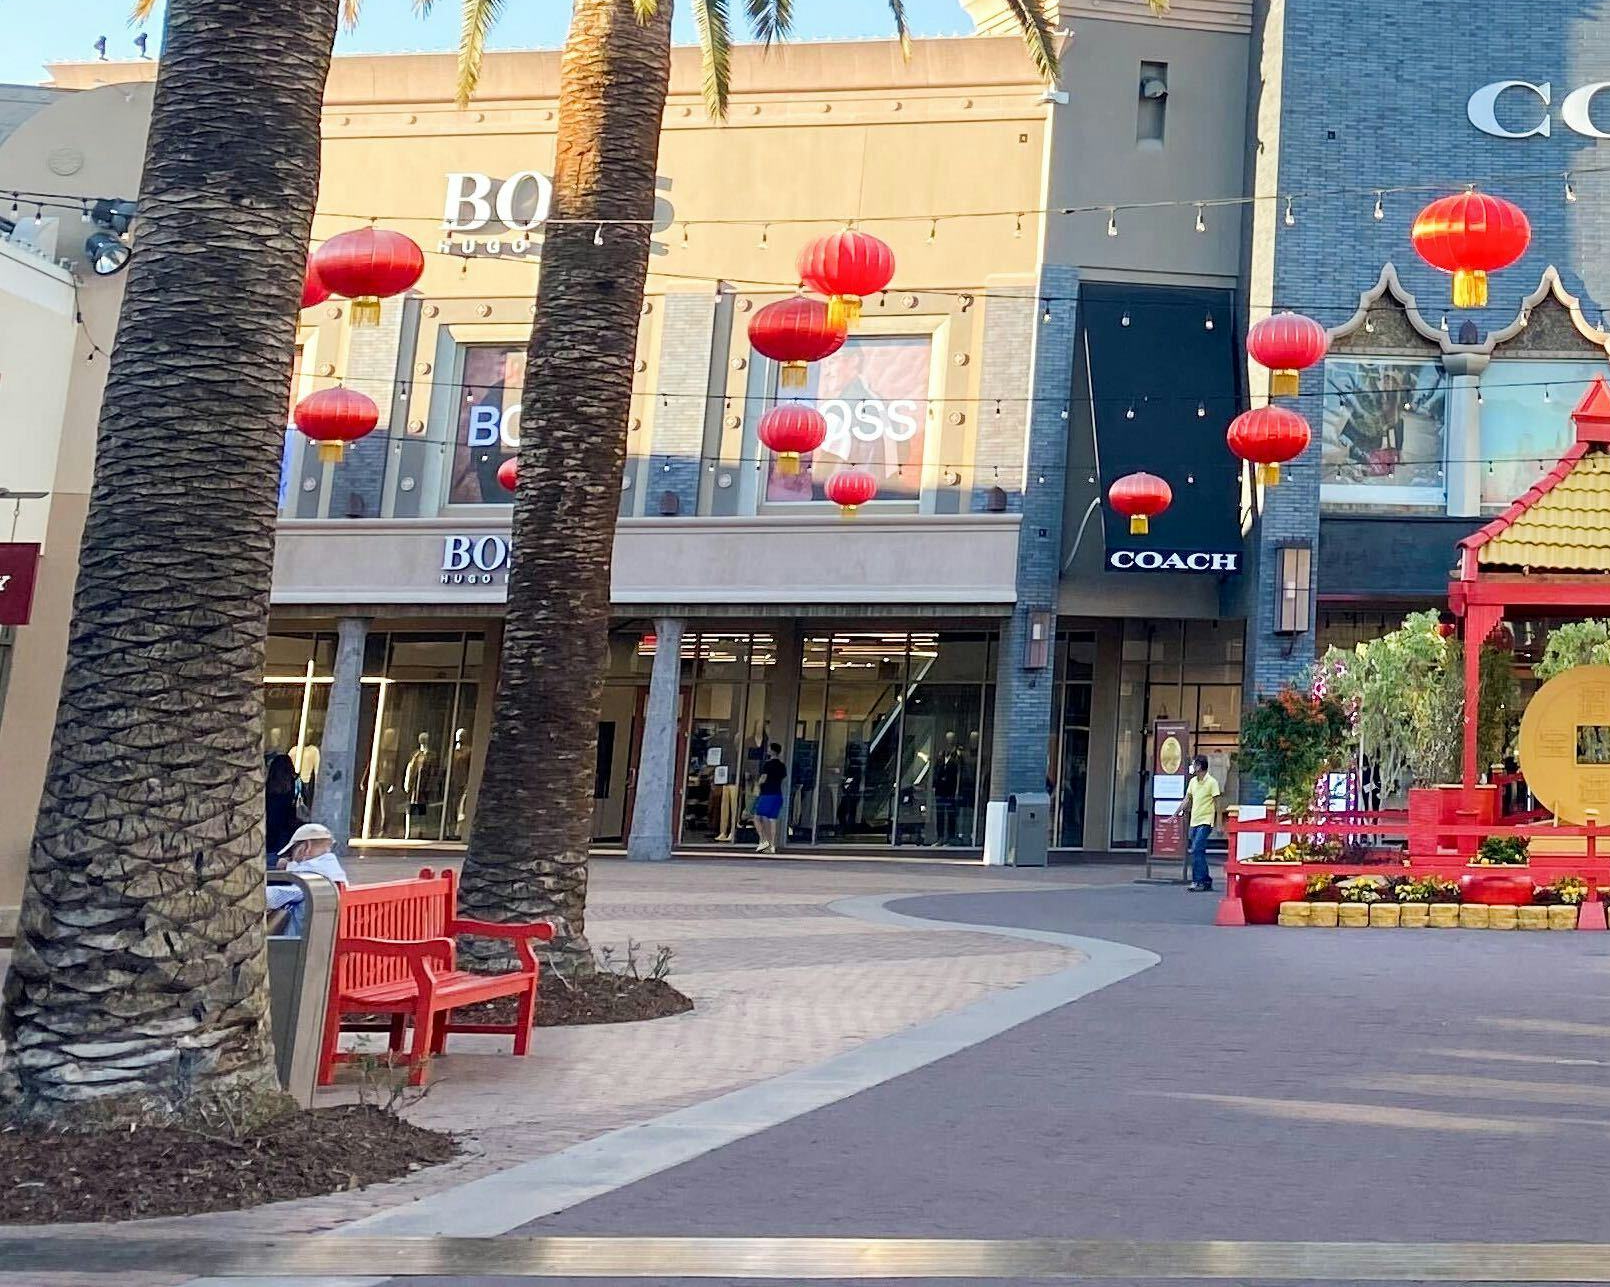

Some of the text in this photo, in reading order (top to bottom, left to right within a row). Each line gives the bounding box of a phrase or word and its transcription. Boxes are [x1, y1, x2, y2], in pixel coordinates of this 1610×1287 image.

[438, 169, 553, 232] BO
[437, 239, 531, 254] HUGO
[818, 399, 917, 442] OSS
[441, 535, 512, 571] BO
[1110, 550, 1238, 571] COACH
[440, 573, 492, 584] HUGO
